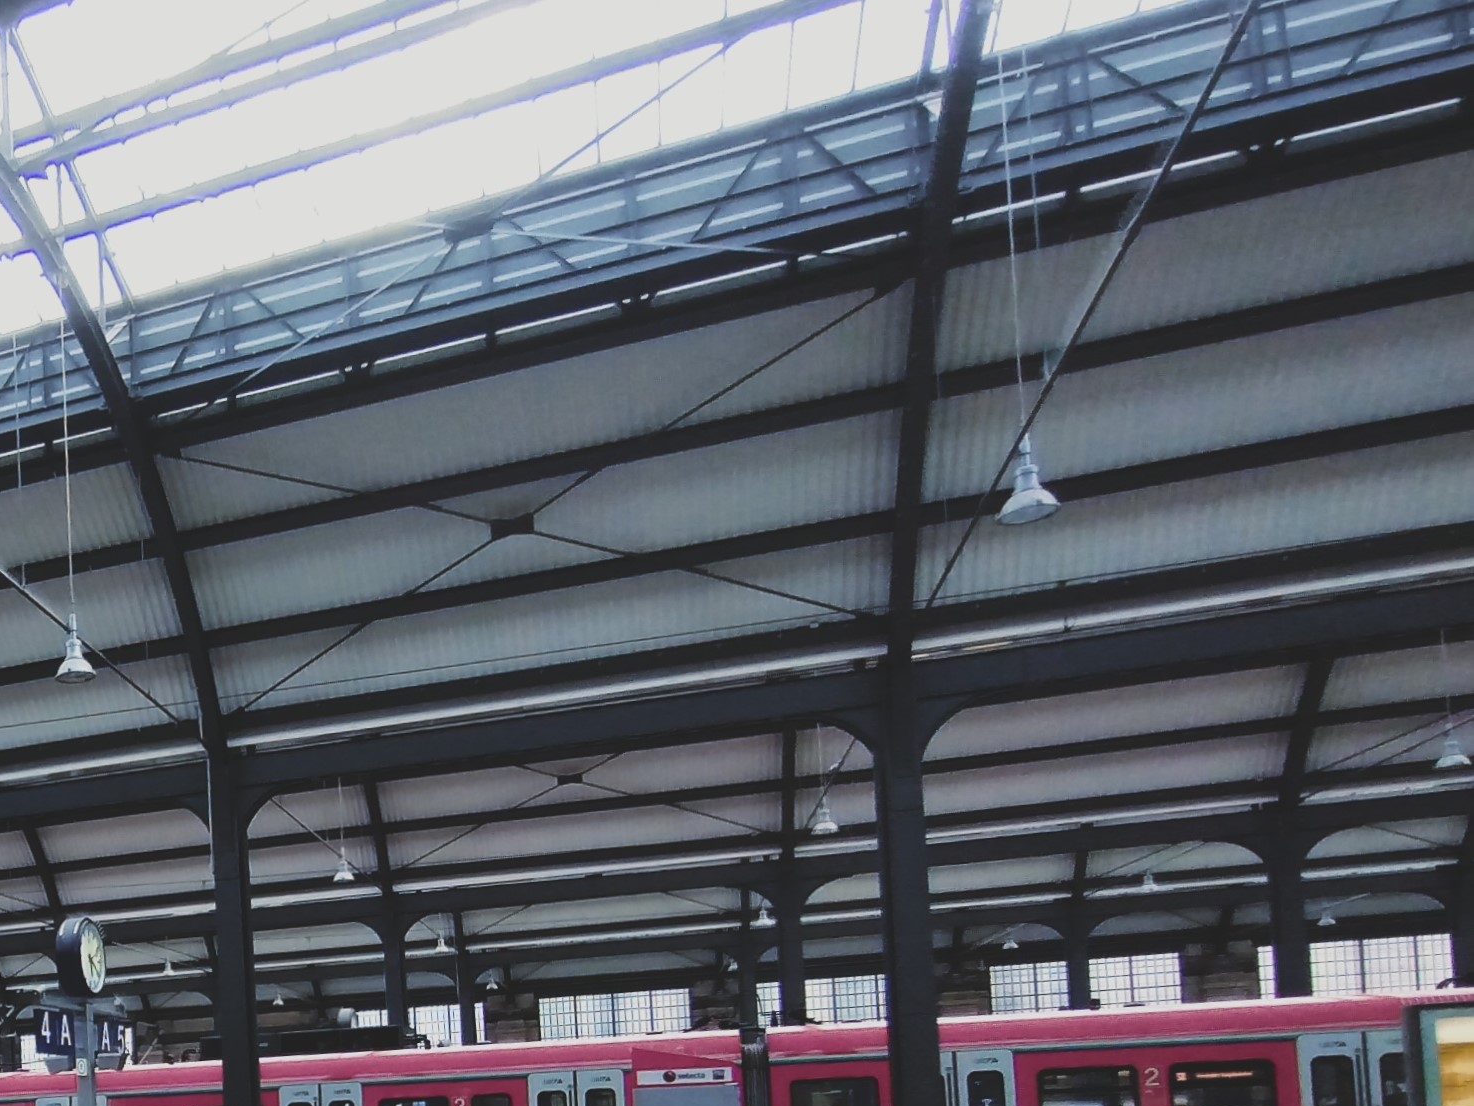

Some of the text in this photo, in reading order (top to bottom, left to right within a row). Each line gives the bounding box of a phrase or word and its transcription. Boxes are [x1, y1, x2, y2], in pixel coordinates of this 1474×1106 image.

[41, 1011, 72, 1046] 4 A
[101, 1021, 125, 1055] A 5
[1144, 1067, 1161, 1086] 2
